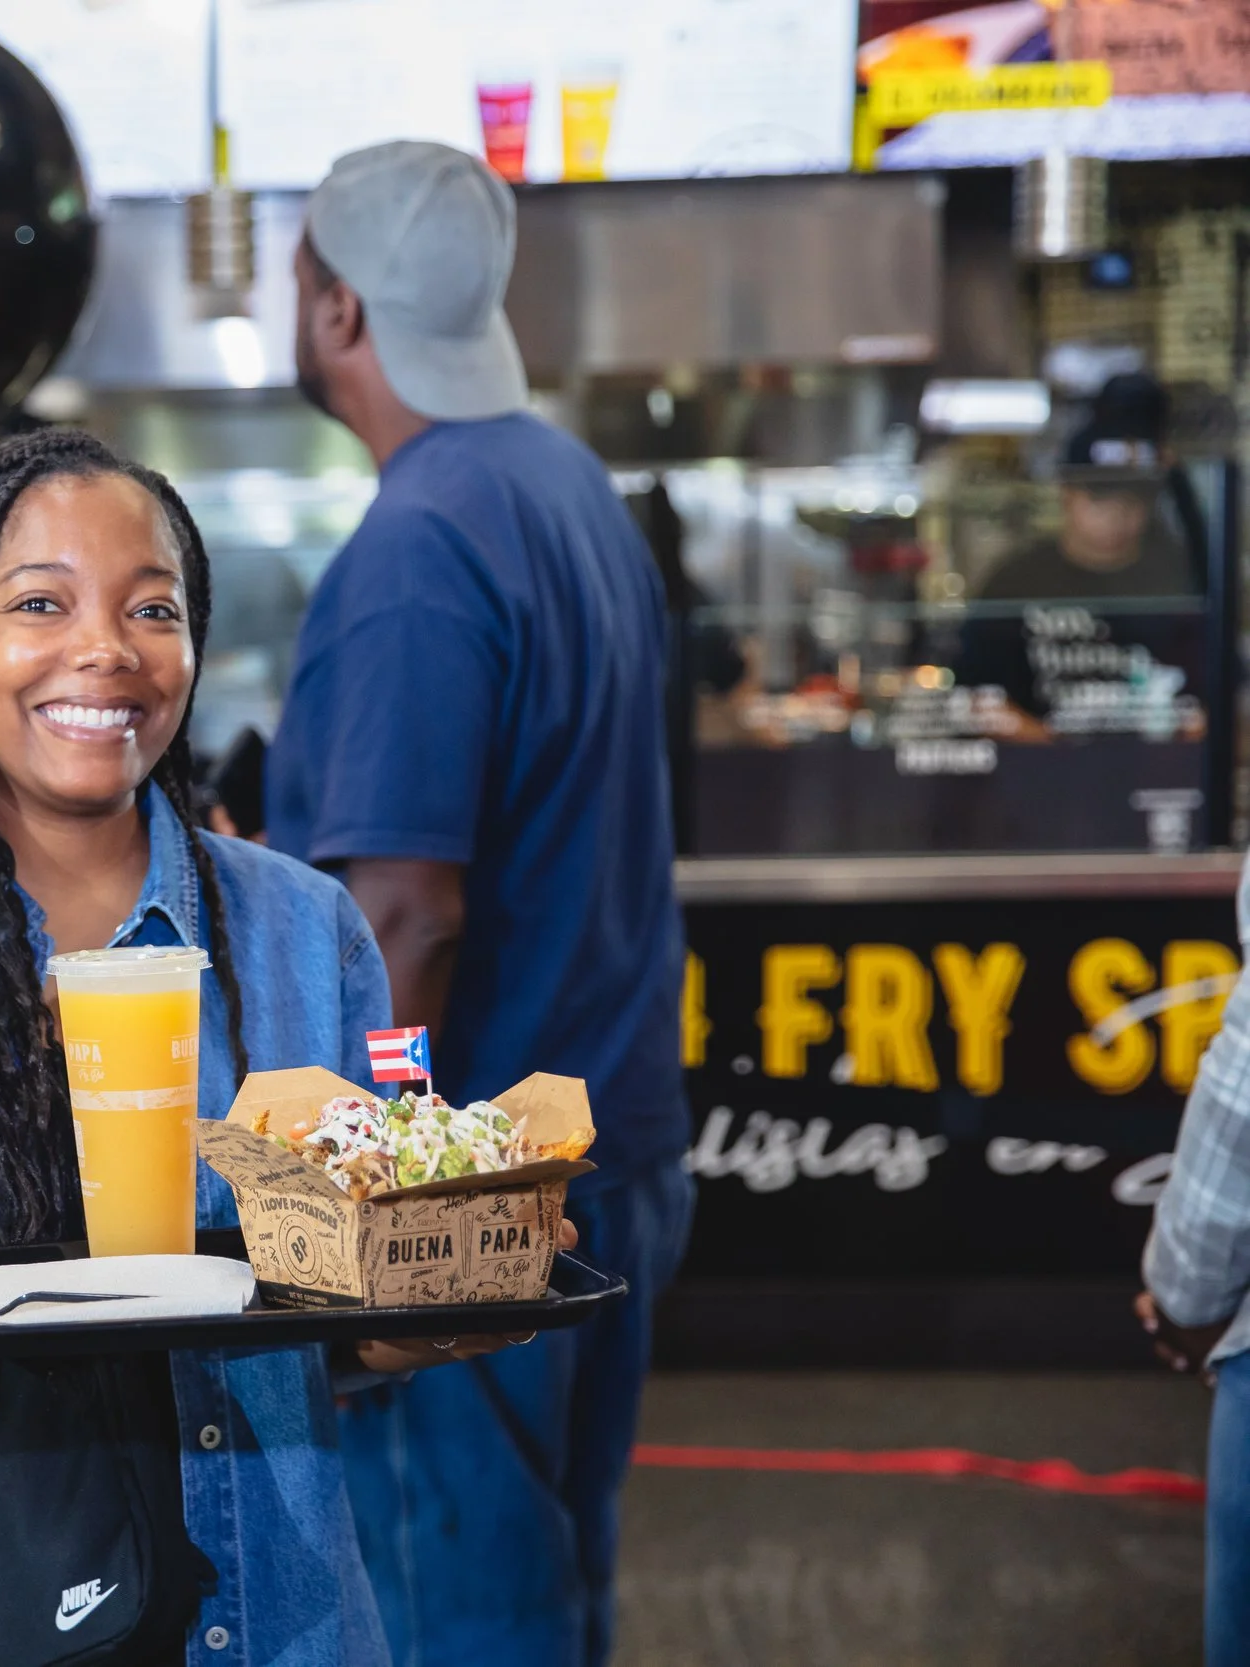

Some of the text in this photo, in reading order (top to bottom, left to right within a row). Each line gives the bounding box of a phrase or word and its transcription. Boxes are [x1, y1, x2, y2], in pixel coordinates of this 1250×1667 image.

[760, 942, 1026, 1096] FRY
[259, 1198, 339, 1231] I LOVE POTATOES
[291, 1235, 308, 1264] BP
[387, 1234, 453, 1265] BUENA
[479, 1226, 530, 1255] PAPA
[494, 1259, 531, 1280] Fry Bar
[61, 1577, 101, 1614] NIKE
